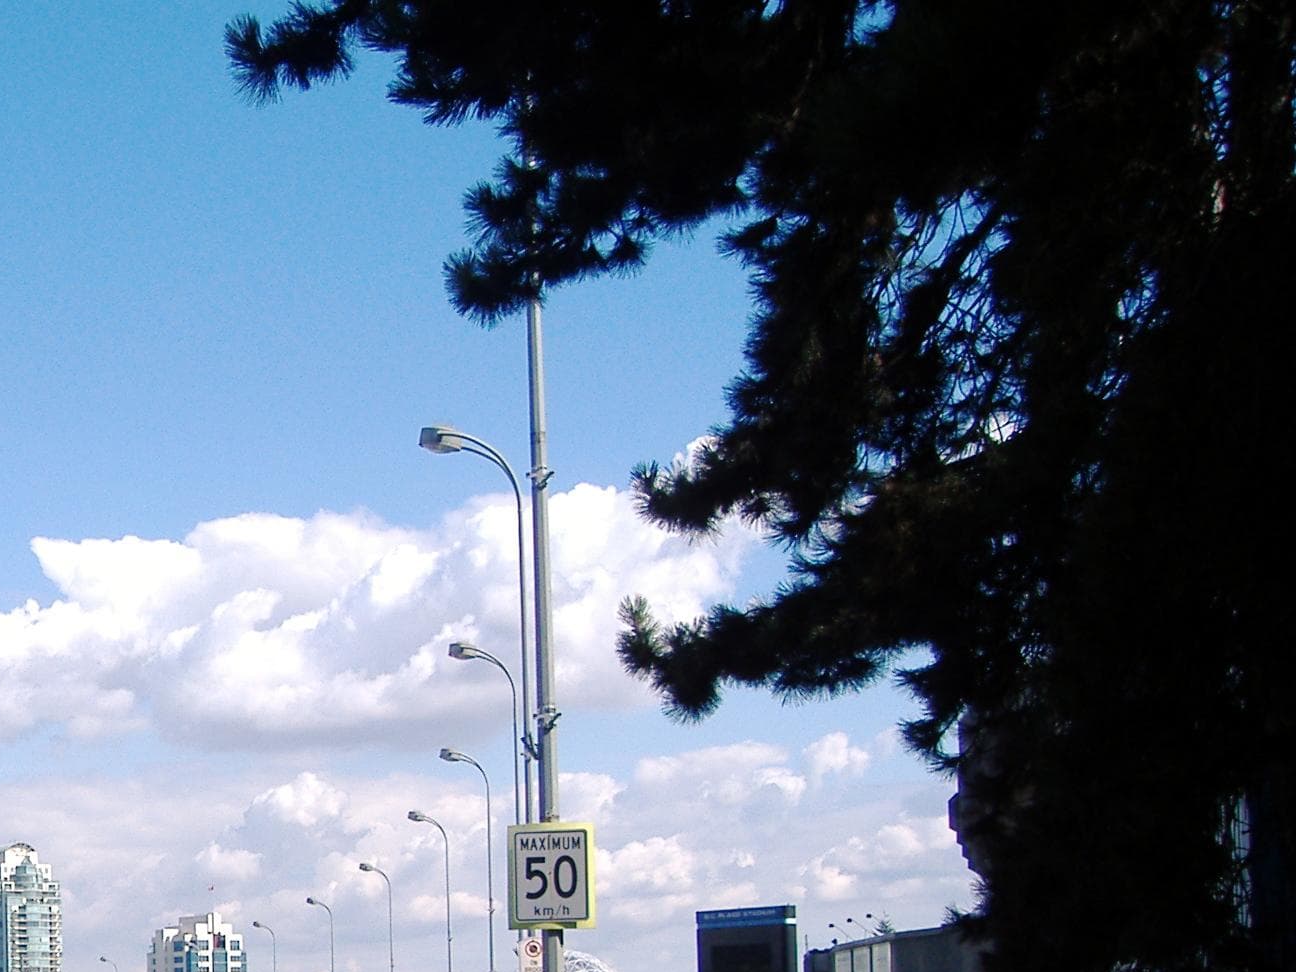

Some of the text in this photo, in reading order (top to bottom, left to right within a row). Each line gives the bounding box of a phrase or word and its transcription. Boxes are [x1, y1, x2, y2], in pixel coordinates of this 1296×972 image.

[520, 836, 581, 851] MAXIMUM
[525, 855, 578, 899] 50
[534, 905, 570, 916] km/h
